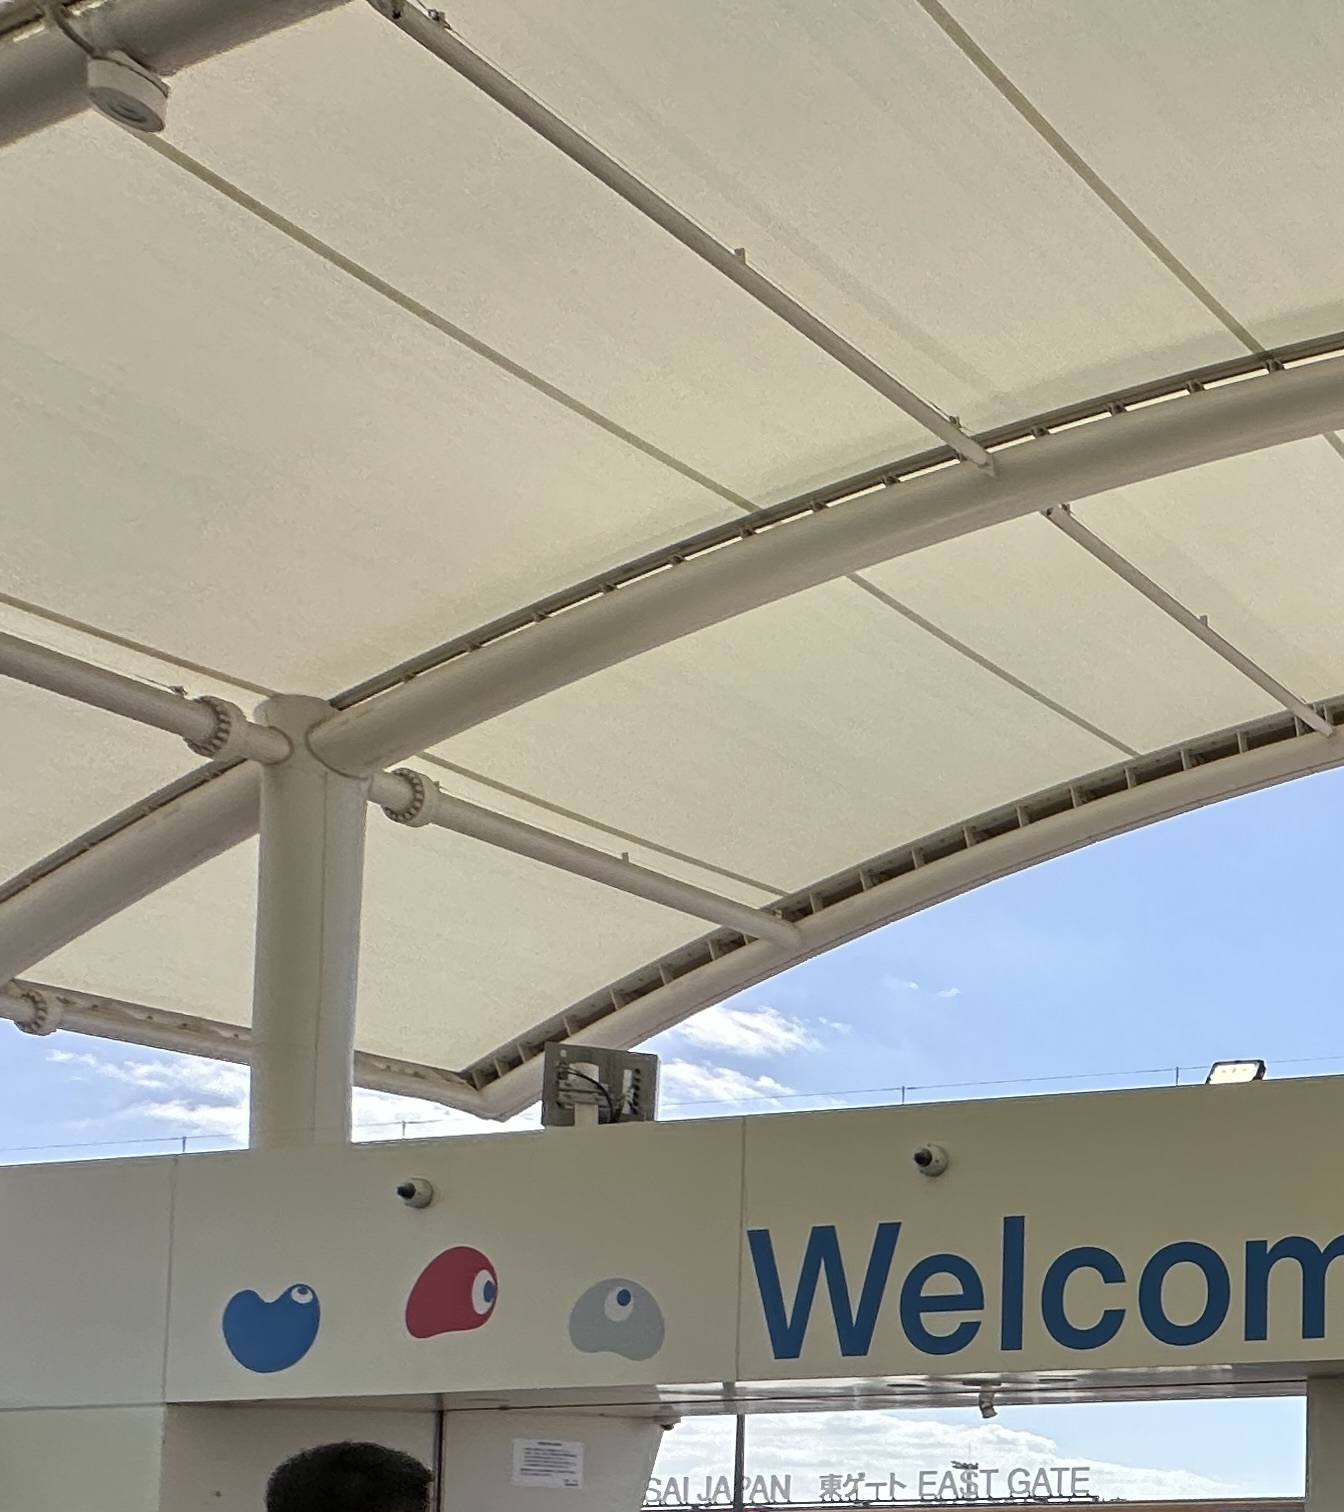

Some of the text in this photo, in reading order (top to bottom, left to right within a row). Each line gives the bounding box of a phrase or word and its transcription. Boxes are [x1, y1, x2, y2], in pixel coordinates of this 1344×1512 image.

[818, 1472, 907, 1499] 東ゲート
[918, 1469, 999, 1499] EAST
[1007, 1466, 1091, 1497] GATE
